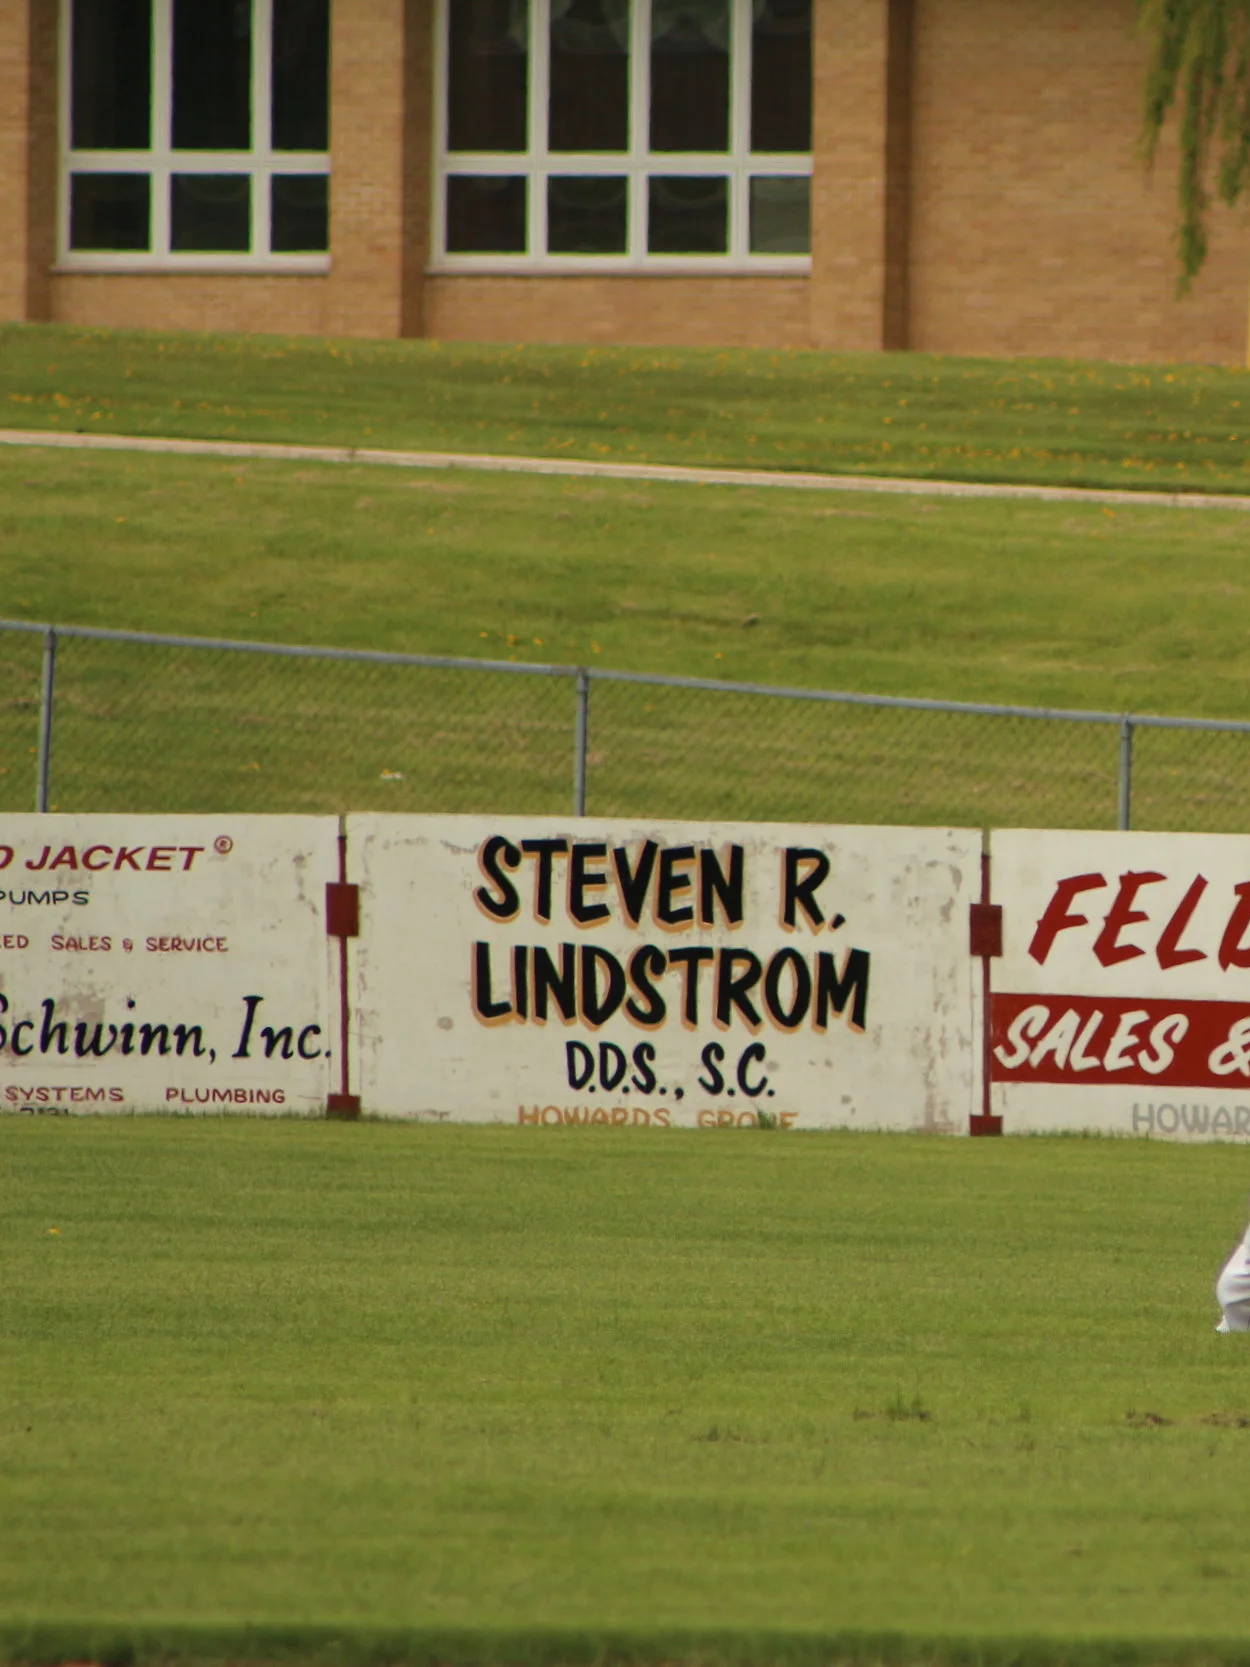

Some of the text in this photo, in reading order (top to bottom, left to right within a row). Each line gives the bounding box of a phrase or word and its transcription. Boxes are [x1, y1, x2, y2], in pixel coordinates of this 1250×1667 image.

[25, 845, 204, 872] JACKET
[474, 836, 846, 934] STEVEN R.
[0, 934, 29, 950] ED
[51, 935, 112, 952] SALES
[146, 936, 228, 953] SERVICE
[471, 941, 870, 1034] LINDSTROM
[231, 994, 332, 1060] Inc.
[994, 1004, 1189, 1076] SALES
[5, 1086, 286, 1104] SYSTEMS PLUMBING
[698, 1042, 776, 1098] S.C.
[517, 1105, 672, 1127] HOWARDS
